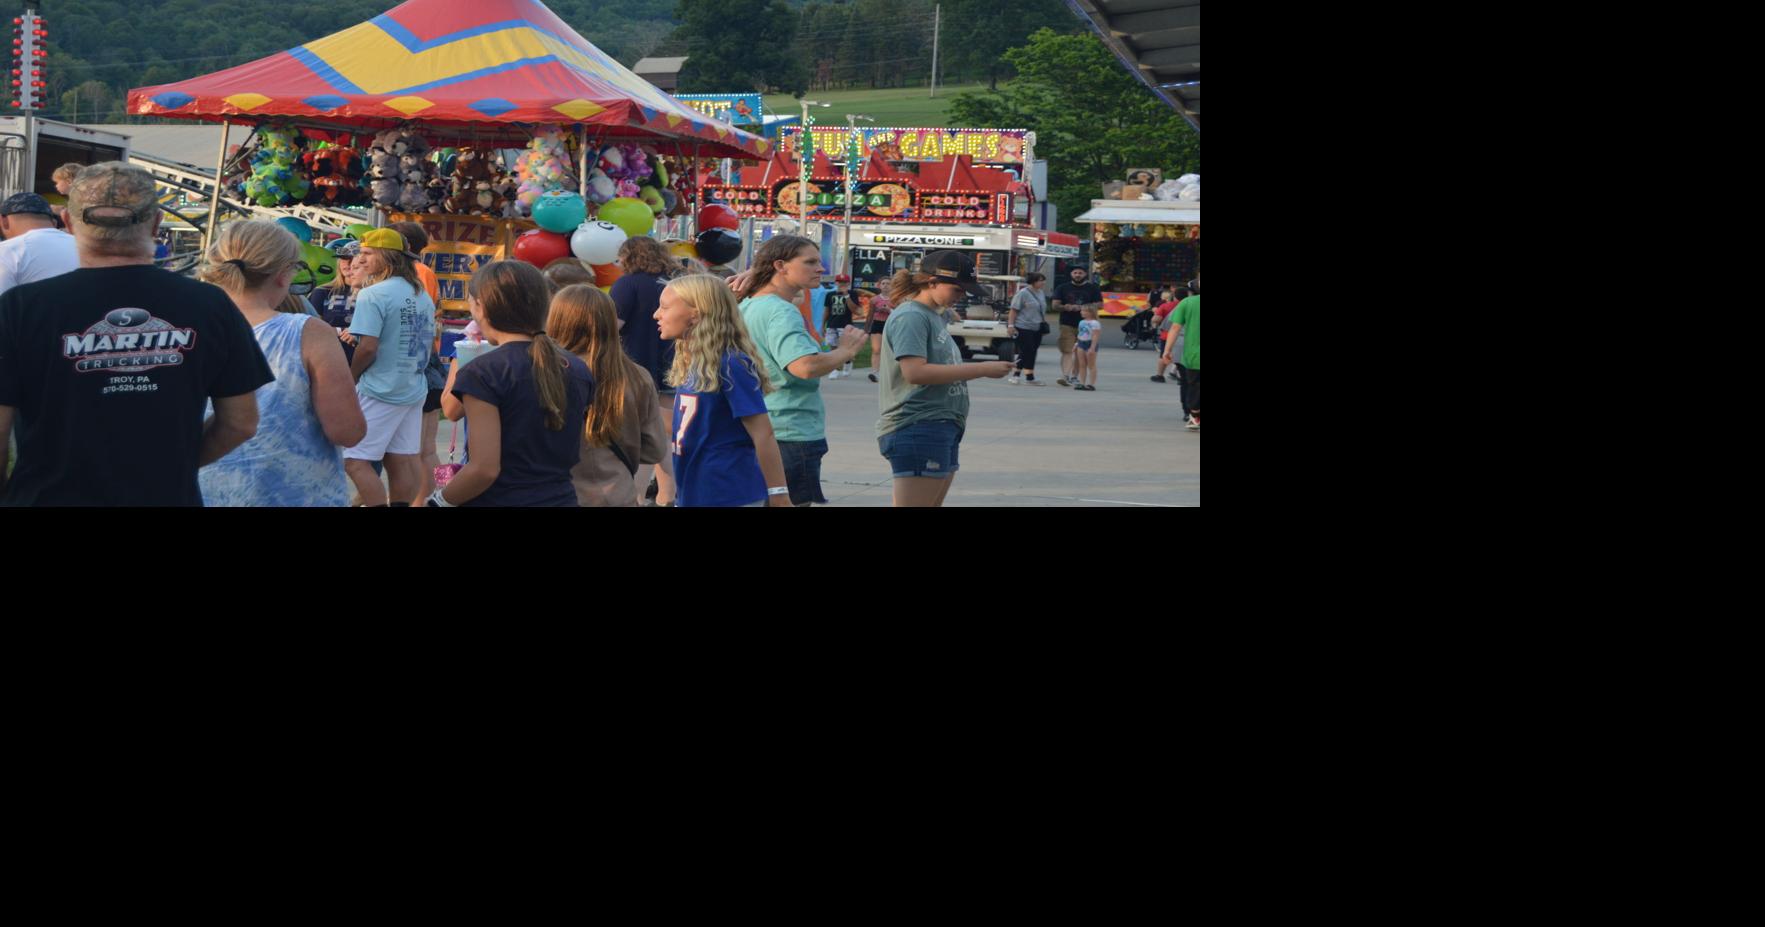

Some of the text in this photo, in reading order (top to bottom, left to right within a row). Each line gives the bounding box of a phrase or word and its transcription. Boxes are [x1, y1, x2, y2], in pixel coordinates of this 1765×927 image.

[900, 133, 999, 157] GAMES
[713, 190, 759, 200] COLD
[803, 193, 882, 205] PIZZA
[931, 195, 980, 205] COLD
[924, 209, 987, 218] DRINKS
[423, 221, 496, 246] RIZE
[885, 236, 963, 245] PIZZA CONE
[421, 252, 494, 273] VERY
[66, 330, 191, 355] MARTIN
[83, 354, 179, 370] TRUCKING
[110, 375, 151, 384] TROY, PA
[103, 383, 159, 394] 570-529-0515
